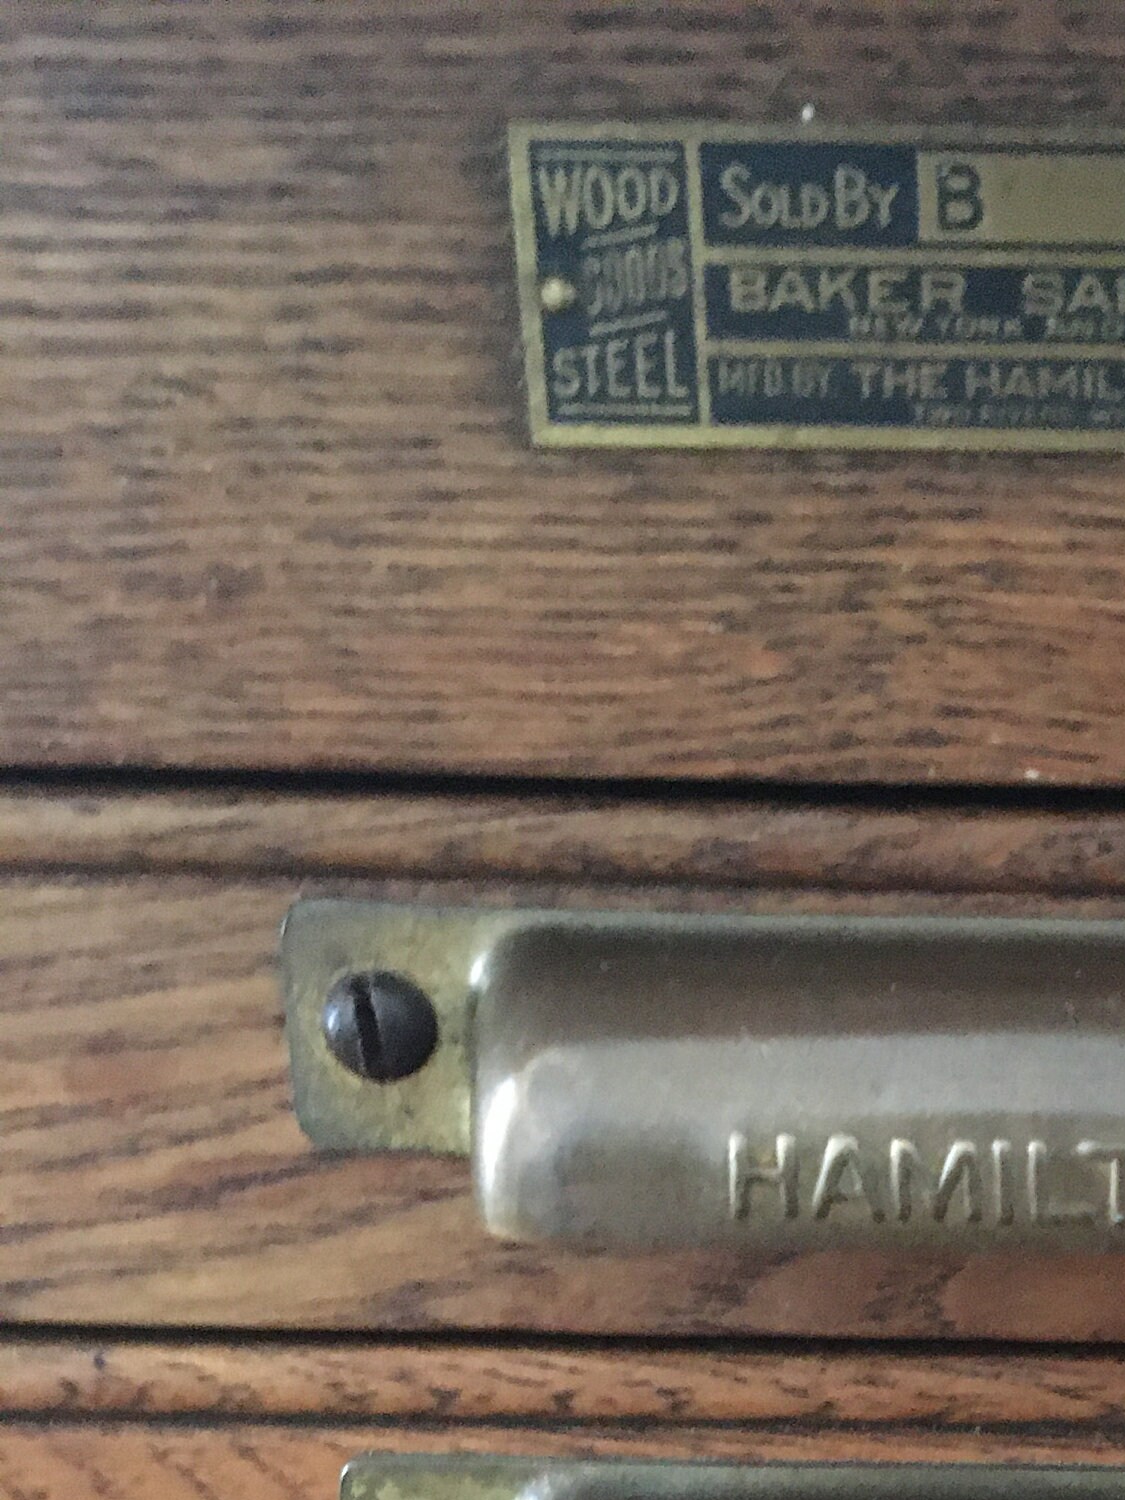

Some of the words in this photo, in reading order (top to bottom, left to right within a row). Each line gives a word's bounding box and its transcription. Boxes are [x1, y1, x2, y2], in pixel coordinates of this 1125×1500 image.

[538, 165, 681, 238] WOOD
[730, 267, 966, 316] BAKER
[553, 329, 690, 398] STEEL
[850, 362, 949, 399] THE
